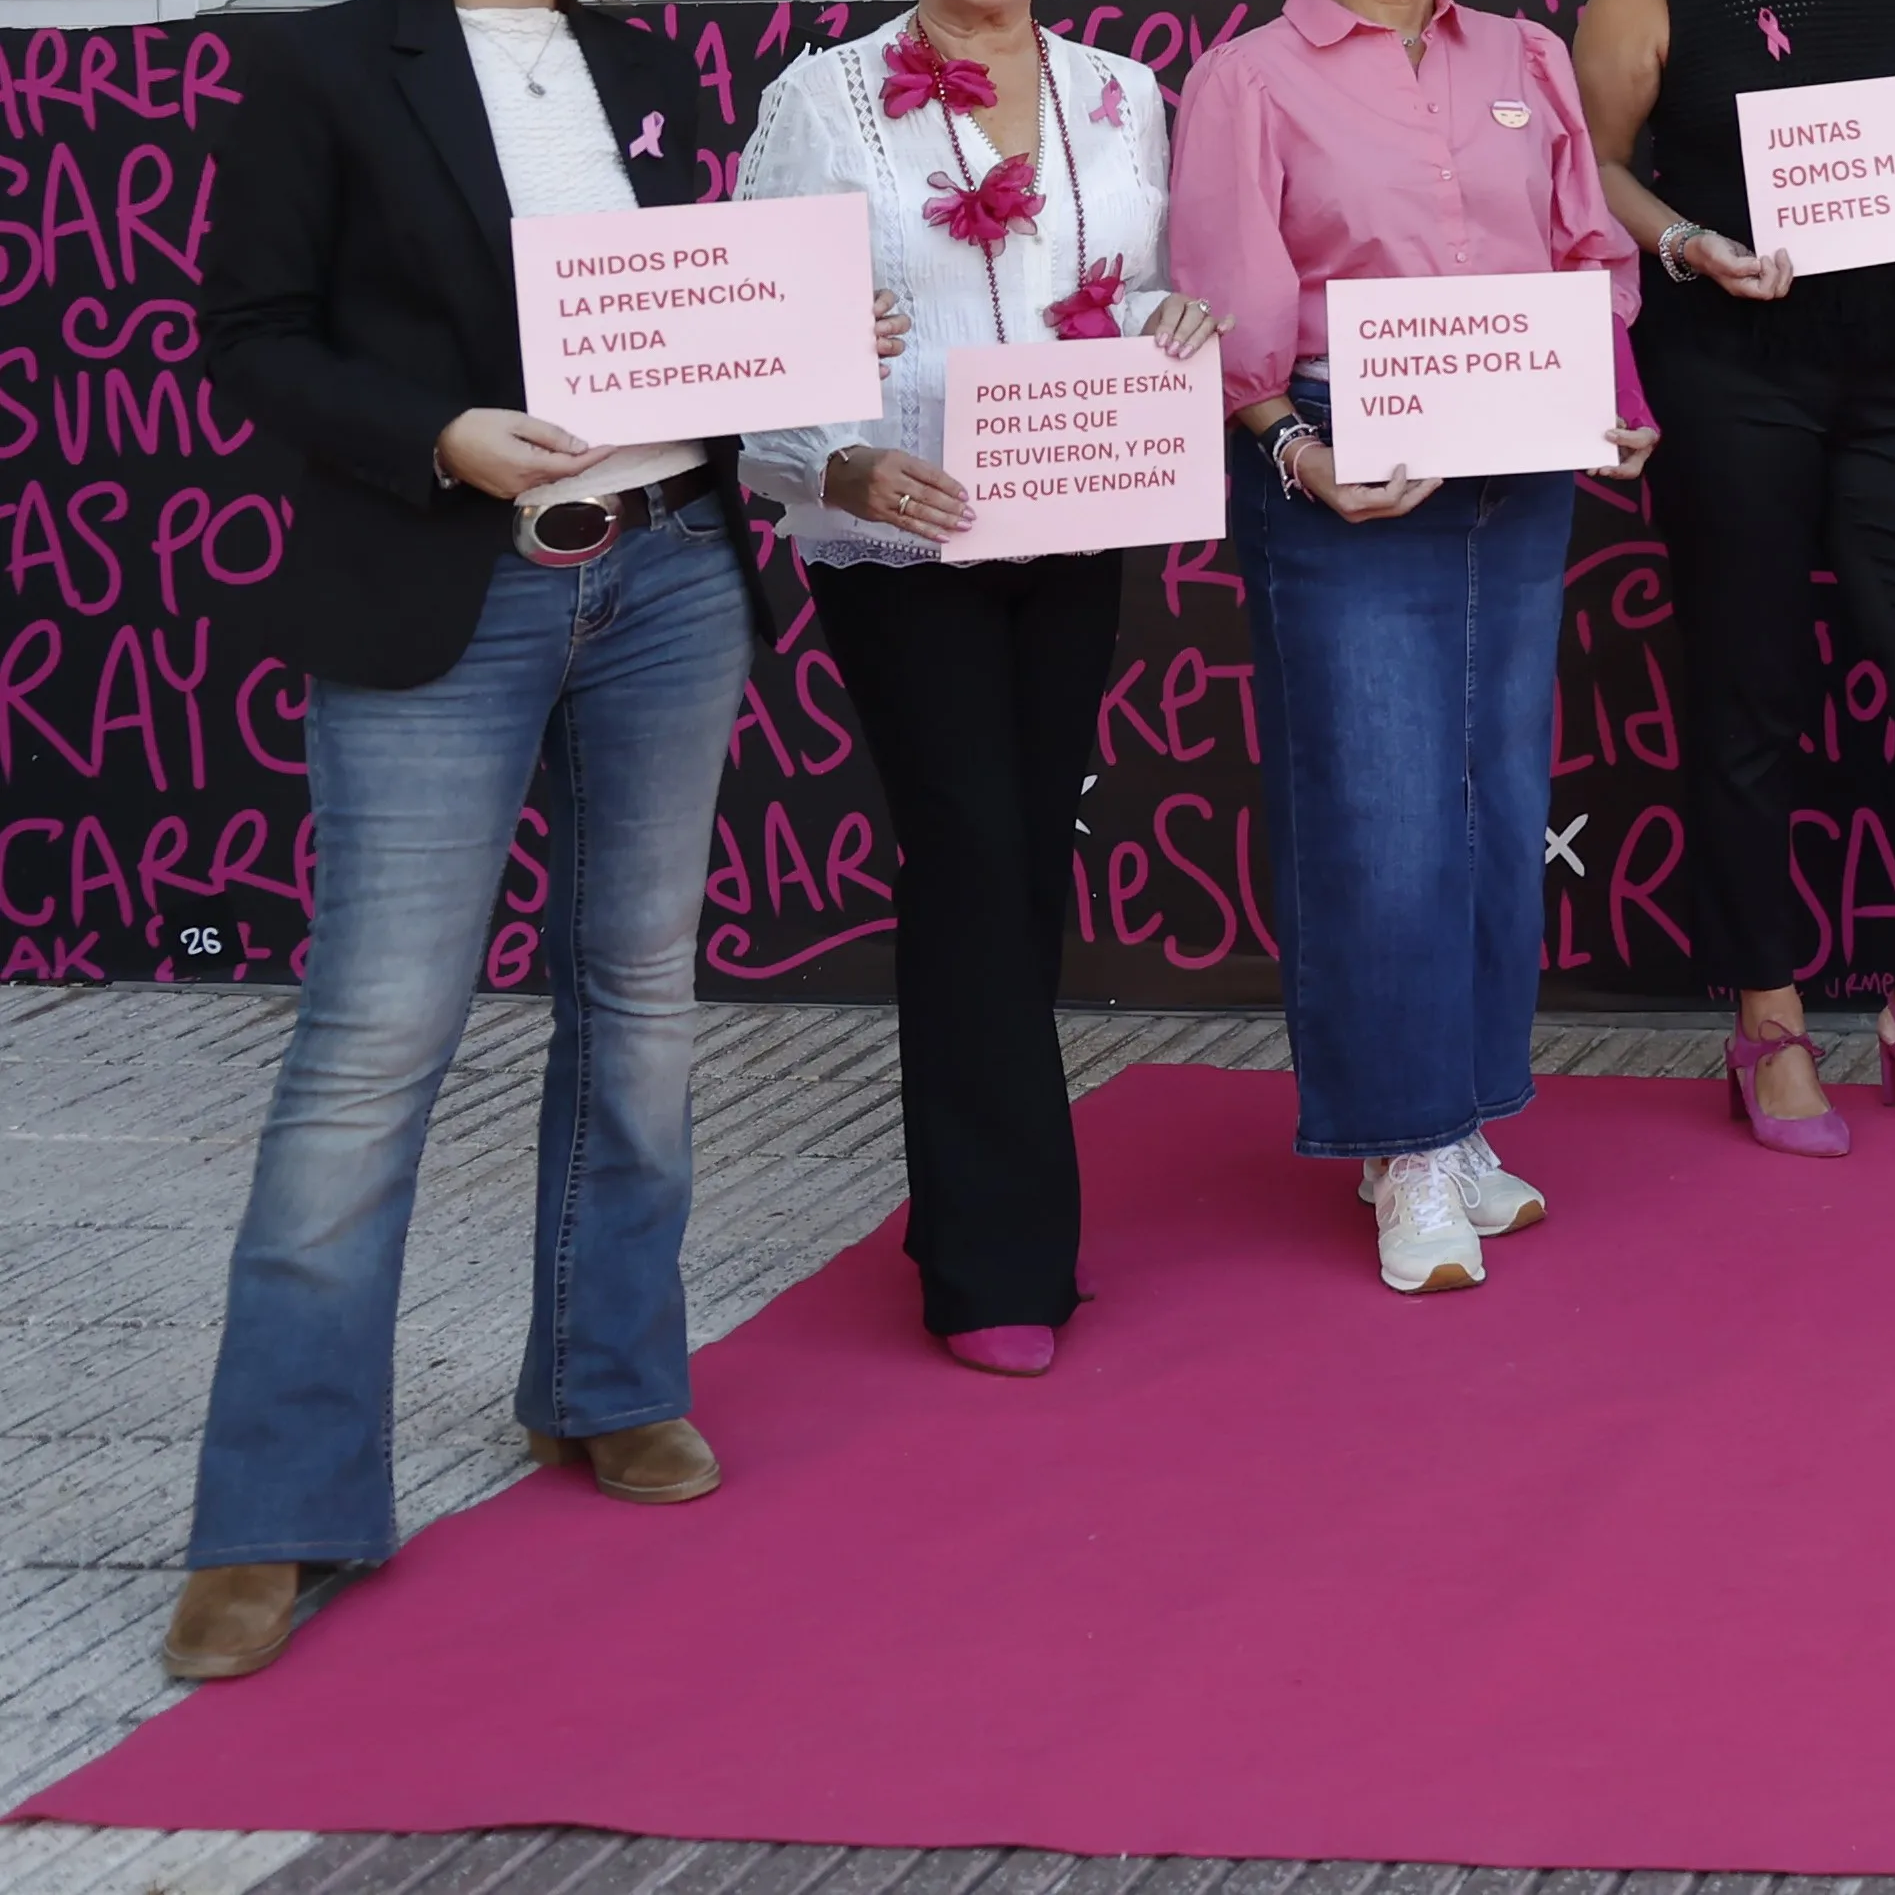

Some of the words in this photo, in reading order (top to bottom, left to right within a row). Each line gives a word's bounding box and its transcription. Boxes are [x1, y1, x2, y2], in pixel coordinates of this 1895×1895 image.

[1768, 120, 1861, 150] JUNTAS
[1772, 159, 1867, 188] SOMOS
[1777, 195, 1890, 228] FUERTES
[556, 252, 665, 278] UNIDOS
[674, 248, 728, 268] POR
[560, 298, 592, 317] LA
[600, 278, 784, 314] PREVENCIÓN,
[1359, 314, 1528, 339] CAMINAMOS
[563, 337, 595, 356] LA
[602, 330, 666, 352] VIDA
[565, 376, 581, 395] Y
[590, 373, 622, 393] LA
[629, 357, 786, 389] ESPERANZA
[1360, 355, 1457, 378] JUNTAS
[1466, 352, 1521, 373] POR
[1530, 350, 1561, 370] LA
[977, 384, 1021, 402] POR
[1029, 381, 1066, 399] LAS
[1073, 378, 1117, 400] QUE
[1124, 371, 1192, 393] ESTÁN,
[1361, 395, 1423, 416] VIDA
[977, 417, 1021, 435] POR
[1028, 414, 1066, 432] LAS
[1073, 410, 1117, 432] QUE
[977, 443, 1119, 468] ESTUVIERON,
[1126, 441, 1137, 457] Y
[1144, 437, 1185, 455] POR
[977, 482, 1016, 501] LAS
[1023, 478, 1067, 500] QUE
[1074, 466, 1175, 493] VENDRÁN
[181, 928, 222, 954] 26
